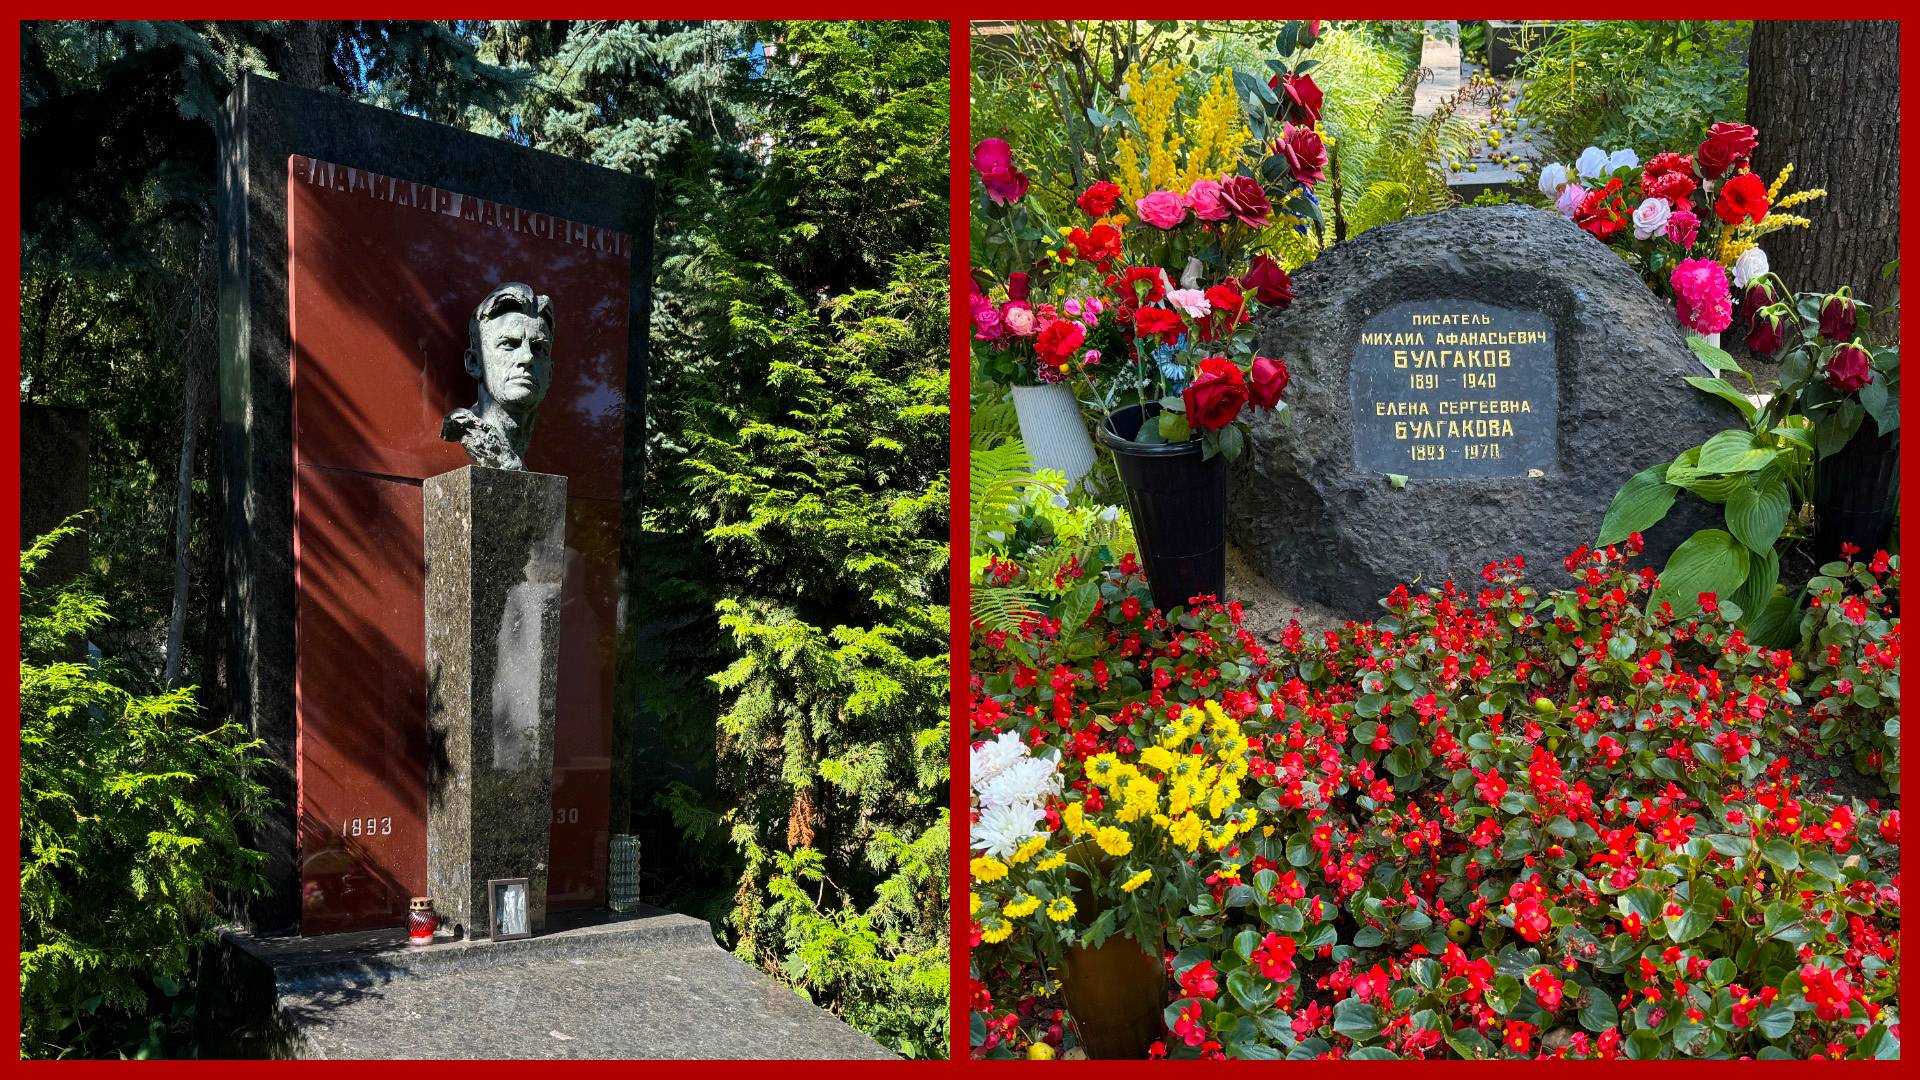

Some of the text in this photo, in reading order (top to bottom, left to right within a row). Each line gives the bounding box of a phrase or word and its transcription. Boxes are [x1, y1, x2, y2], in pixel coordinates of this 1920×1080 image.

[1412, 314, 1491, 326] ПИСАТЕЛЬ
[1361, 331, 1546, 346] МИХАИЛ АФАНАСЬЕВИЧ
[1394, 350, 1511, 369] БУЛГАКОВ
[1410, 373, 1439, 390] 1891
[1463, 373, 1496, 389] 1940
[1376, 400, 1531, 416] ЕЛЕНА СЕРГЕЕВНА
[1395, 419, 1514, 440] БУЛГАКОВА
[1411, 444, 1445, 461] 1893
[1464, 443, 1500, 460] 1970
[342, 816, 392, 837] 1893
